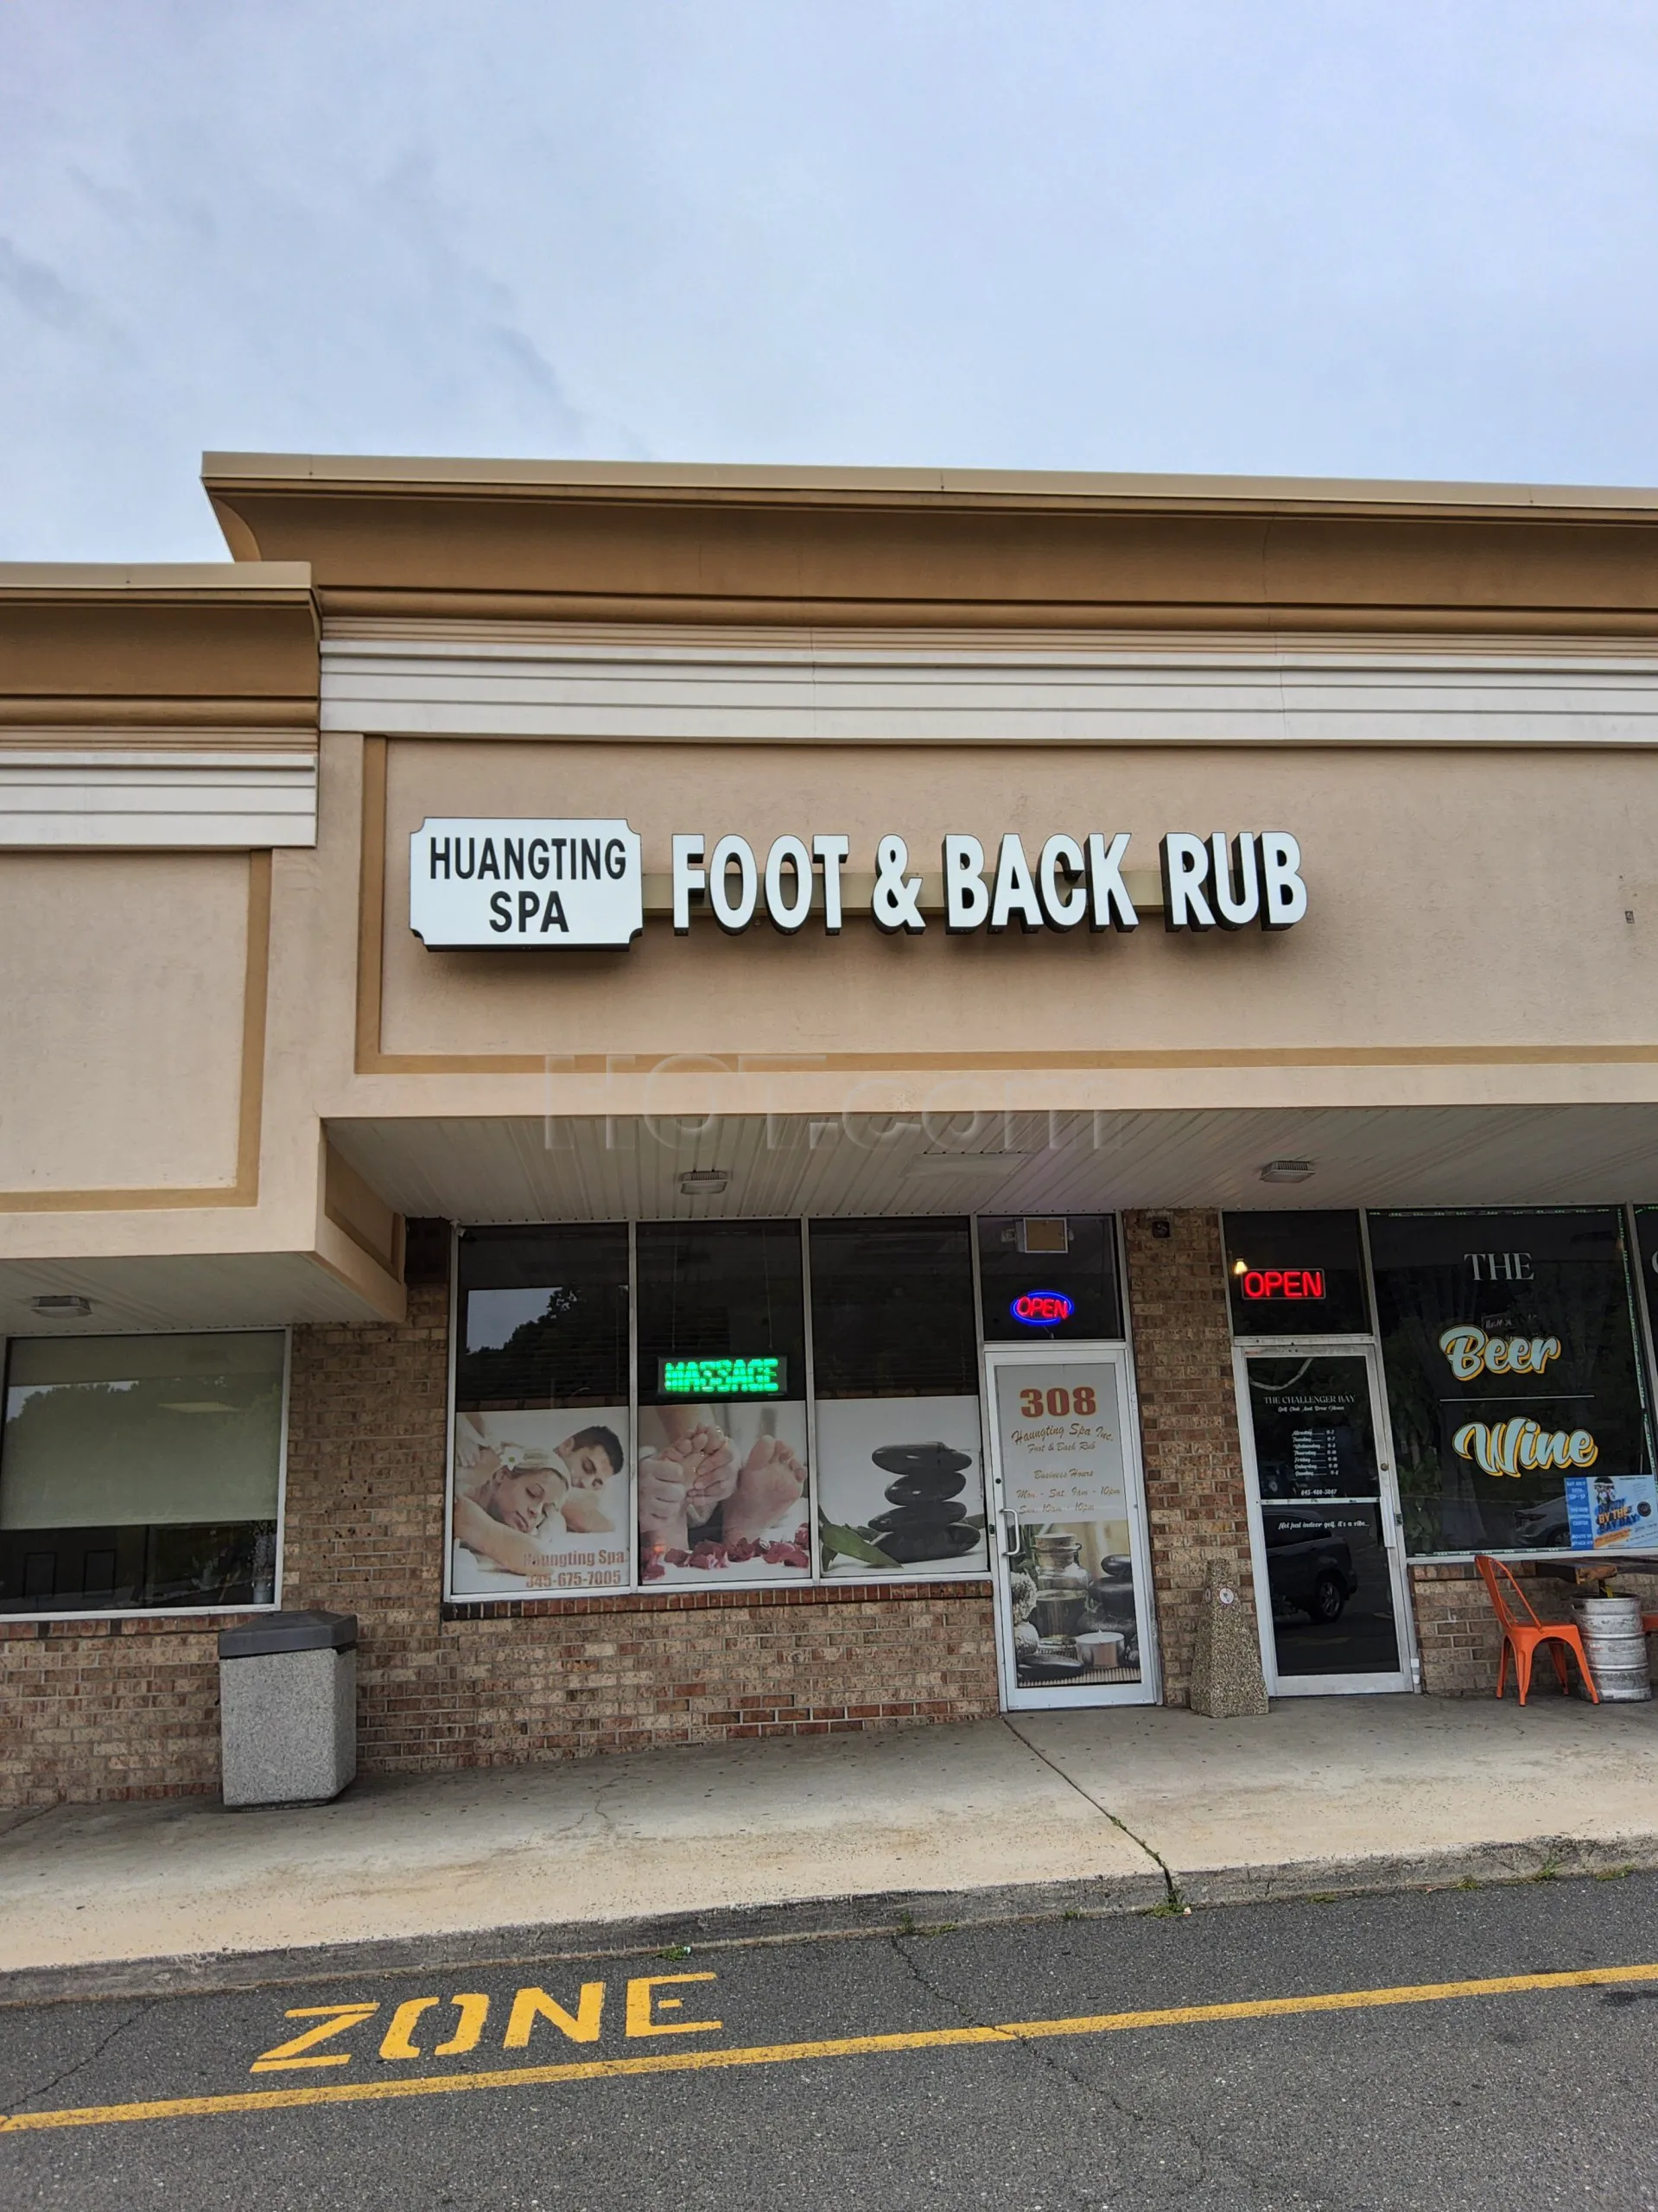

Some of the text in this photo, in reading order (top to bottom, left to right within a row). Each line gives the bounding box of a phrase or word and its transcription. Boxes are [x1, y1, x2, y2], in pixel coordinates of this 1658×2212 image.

[430, 836, 626, 880] HUANGTING
[671, 831, 1308, 935] FOOT & BACK RUB
[489, 891, 569, 933] SPA
[1464, 1252, 1534, 1281] THE
[1244, 1271, 1322, 1298] OPEN
[1016, 1296, 1068, 1320] OPEN
[1439, 1325, 1562, 1382] Beer
[664, 1358, 779, 1392] MASSAGE
[1020, 1386, 1096, 1418] 308
[1282, 1395, 1336, 1404] CHALLENGER
[1338, 1395, 1356, 1403] BAY
[1069, 1422, 1090, 1437] Spa
[1096, 1426, 1114, 1441] Inc.
[1027, 1441, 1096, 1453] Foot & Back Rub
[1452, 1416, 1598, 1478] Wine
[1034, 1468, 1094, 1479] Business Hours
[1598, 1506, 1629, 1523] BY THE
[599, 1549, 625, 1565] Spa
[250, 1971, 723, 2073] ZONE
